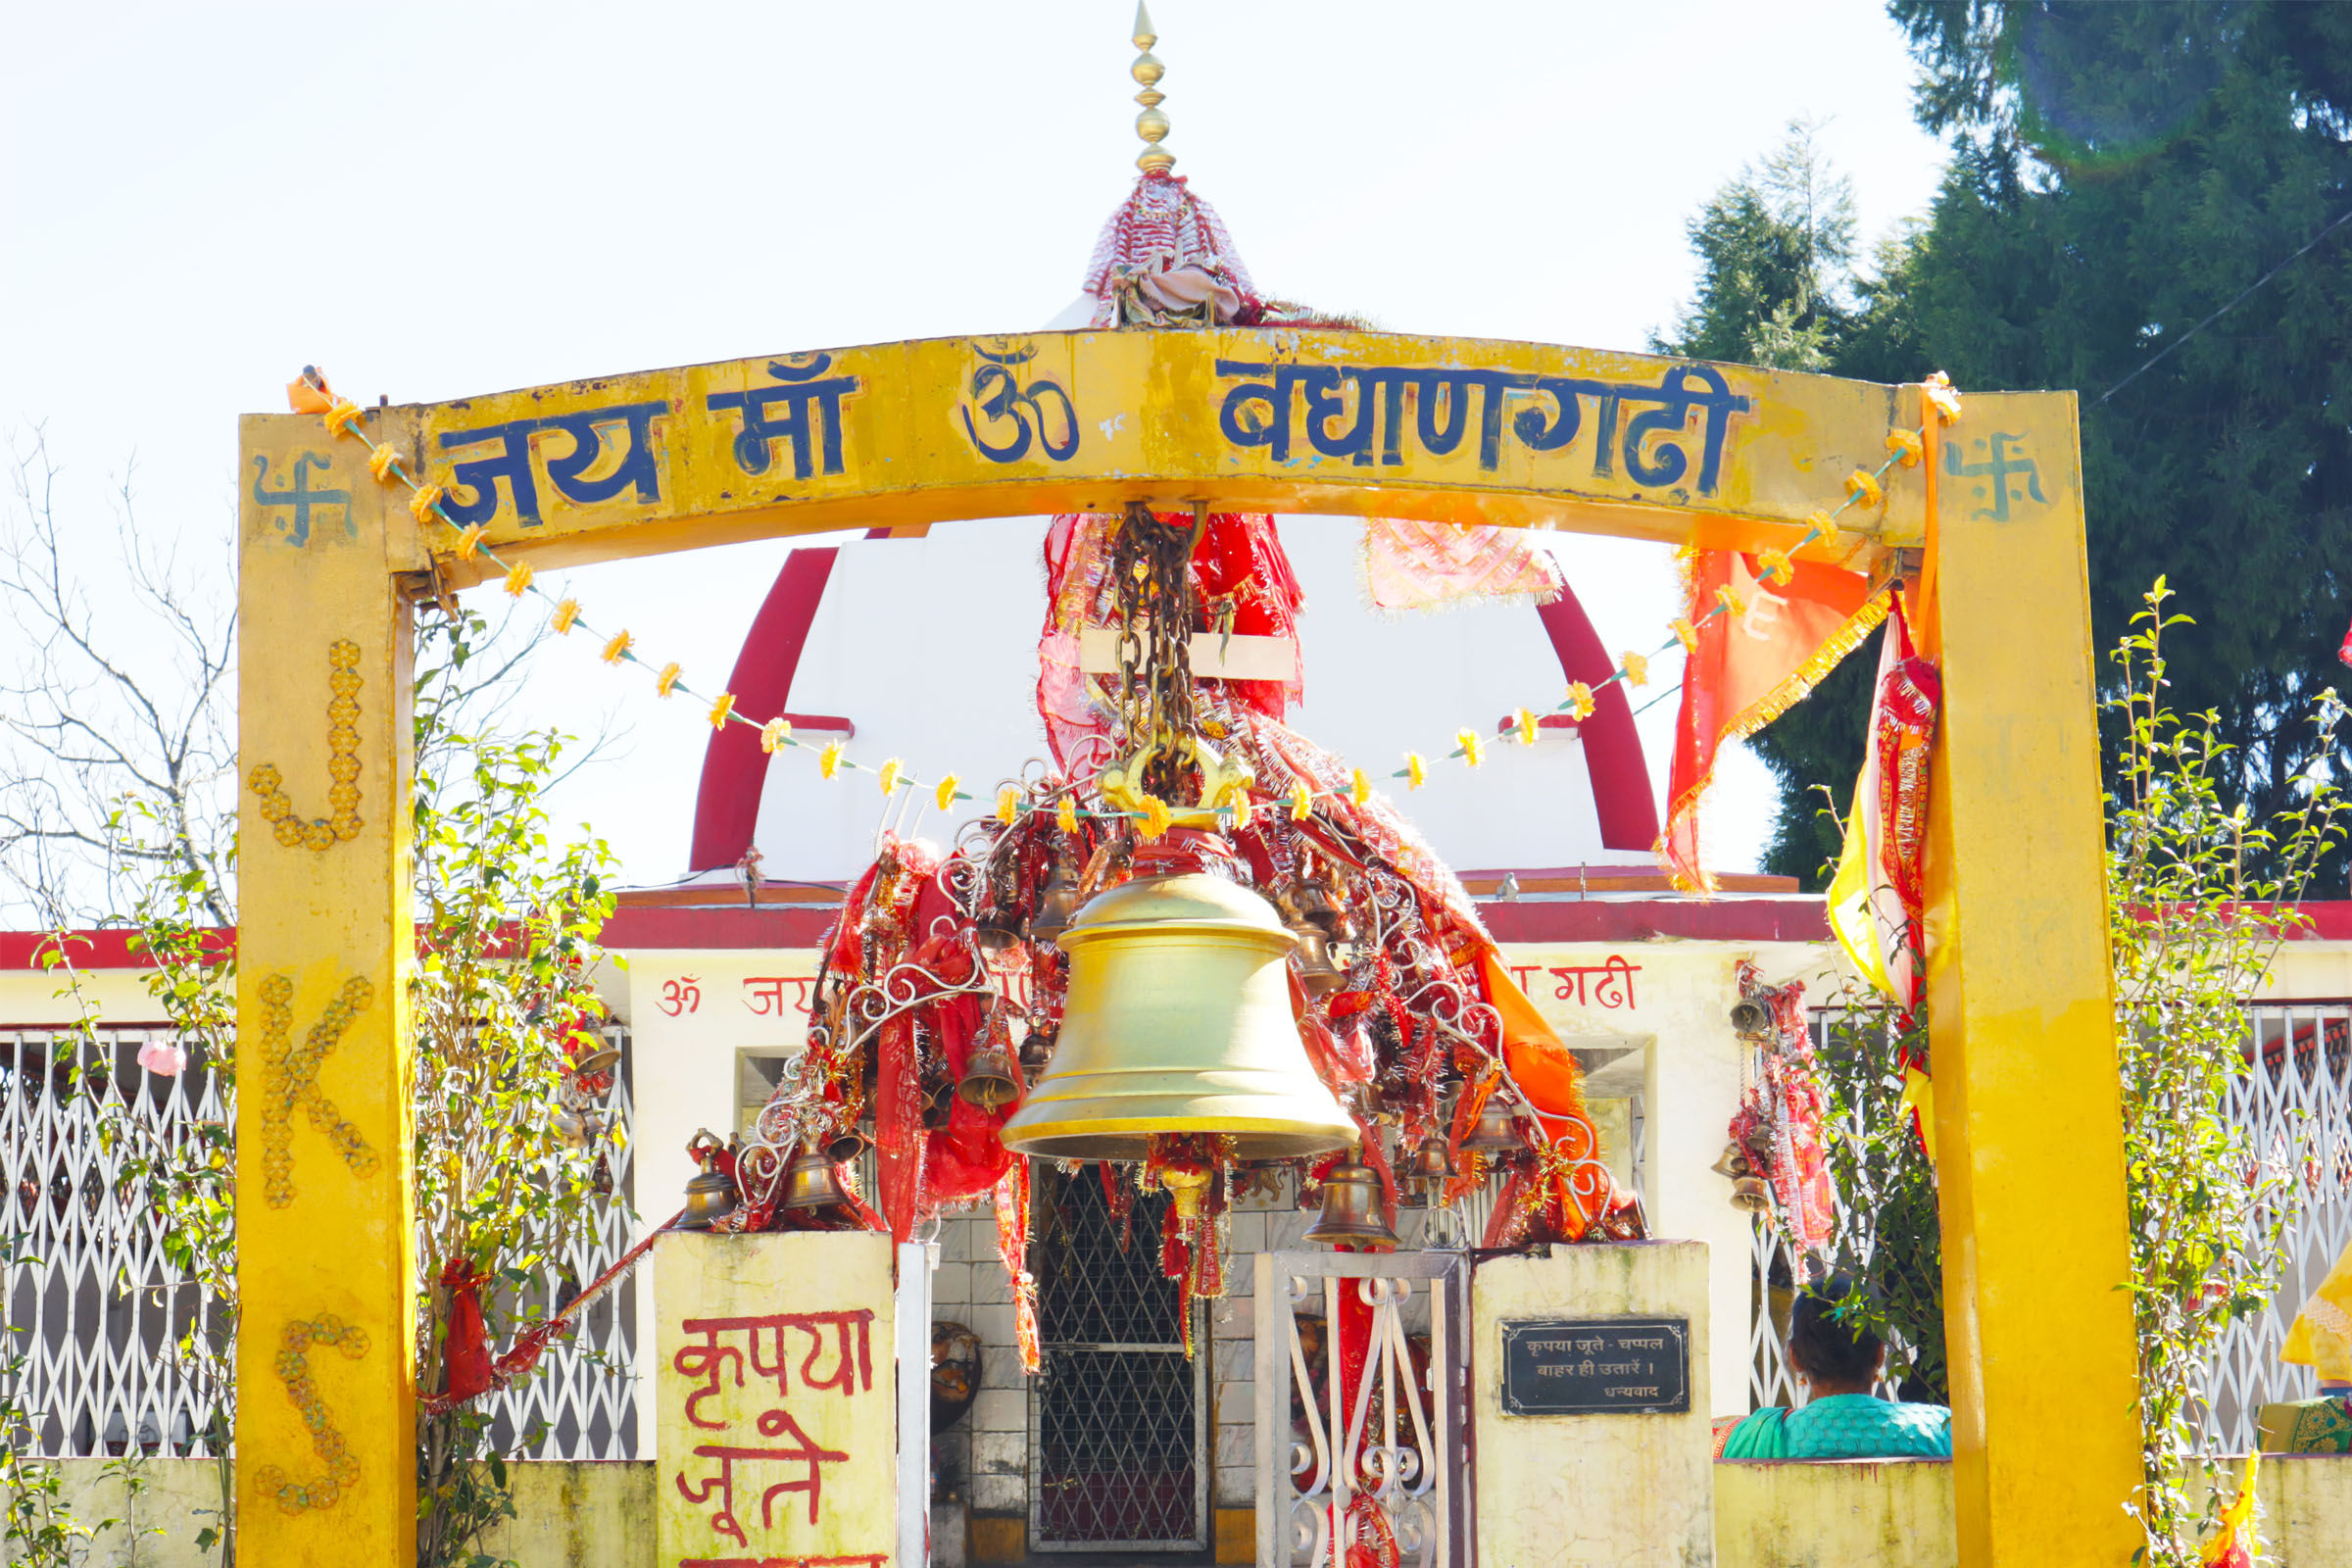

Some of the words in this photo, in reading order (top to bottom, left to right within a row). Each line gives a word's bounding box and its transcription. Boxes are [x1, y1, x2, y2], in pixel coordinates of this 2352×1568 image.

[439, 400, 669, 529] जय
[962, 336, 1080, 463] ॐ
[656, 973, 702, 1017] ॐ
[1526, 1341, 1572, 1356] कृपया
[1575, 1335, 1604, 1355] जूते
[1617, 1338, 1664, 1350] चप्पल
[673, 1308, 874, 1430] कृपया
[1537, 1364, 1574, 1378] बाहर
[1578, 1359, 1594, 1377] ही
[1604, 1386, 1660, 1397] धन्यवाद
[676, 1409, 850, 1547] जूते
